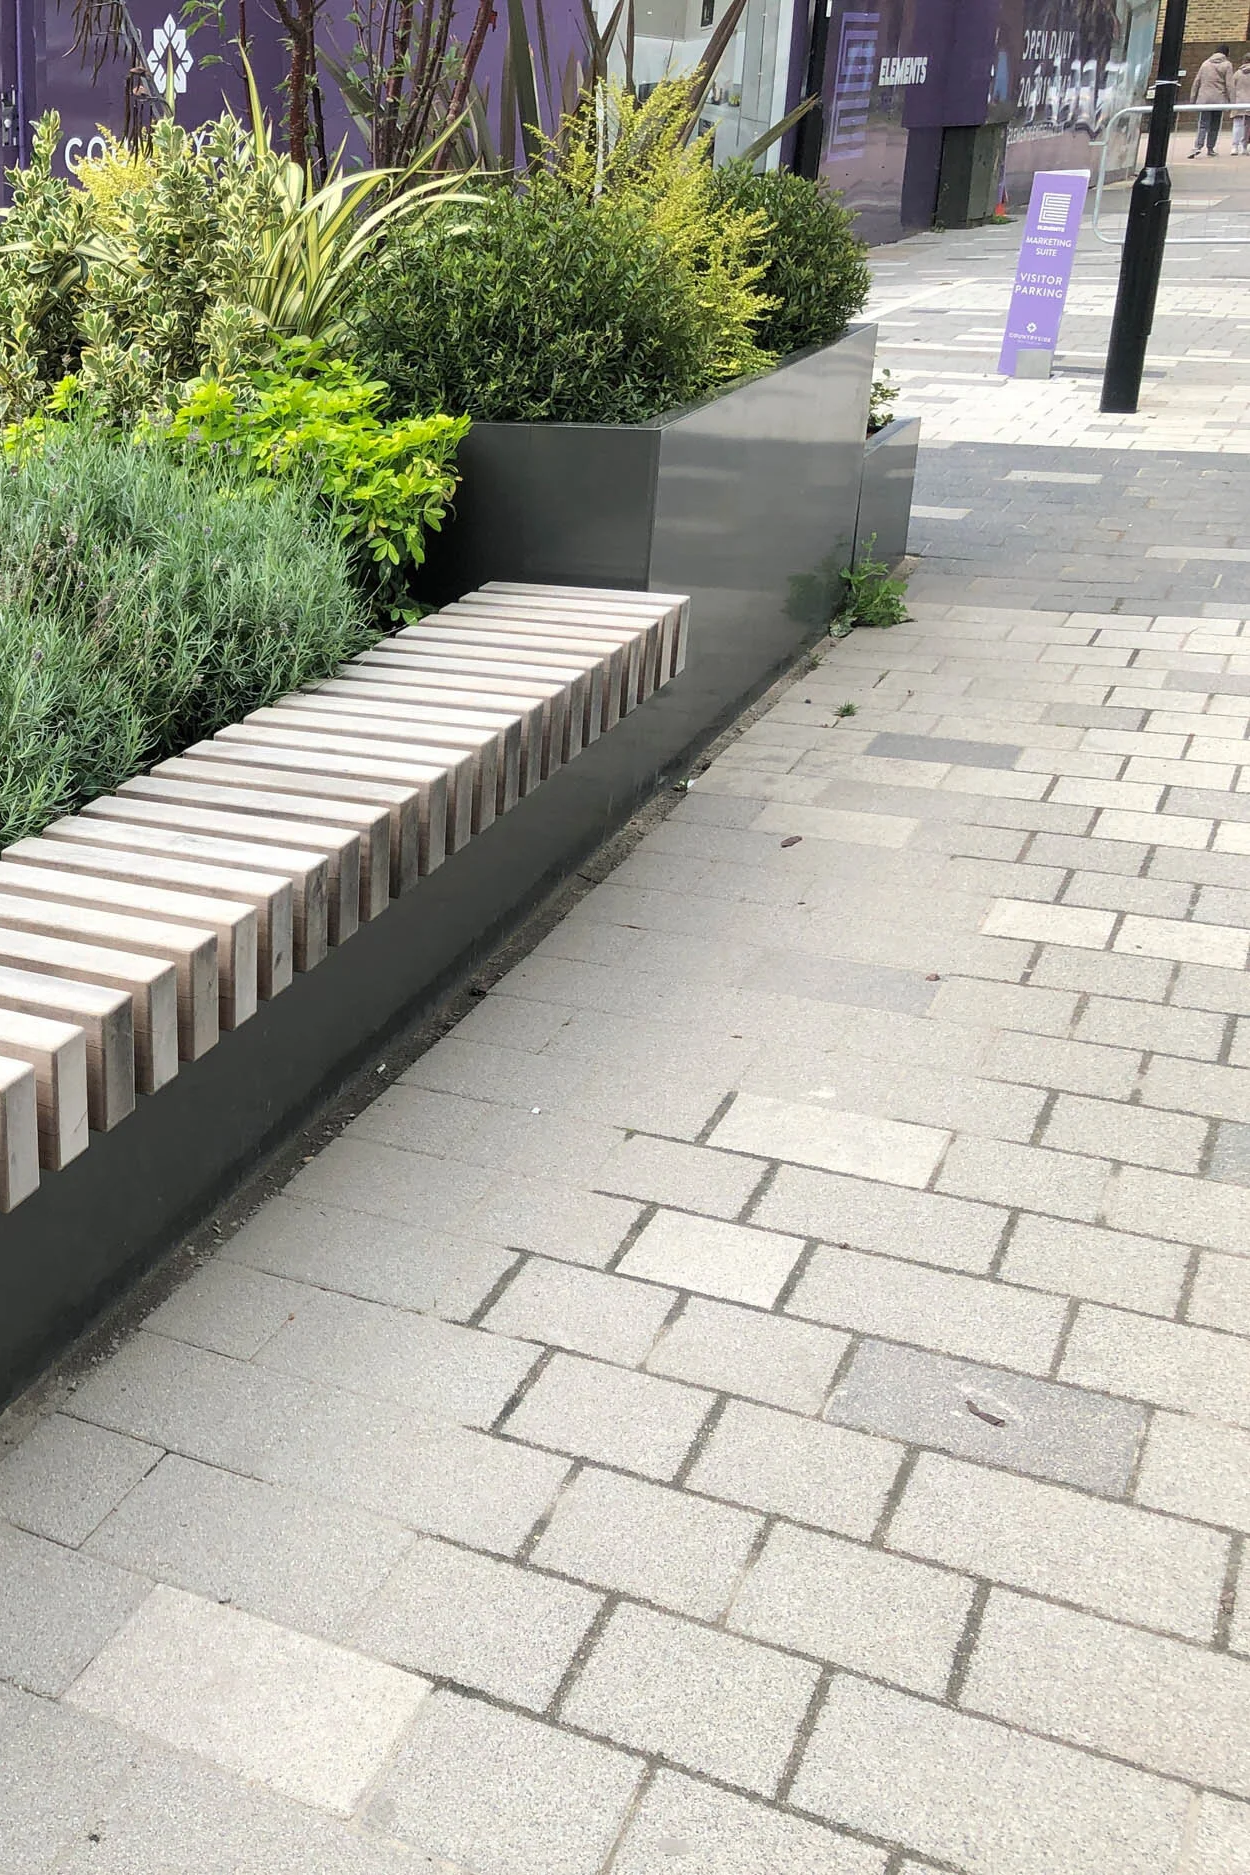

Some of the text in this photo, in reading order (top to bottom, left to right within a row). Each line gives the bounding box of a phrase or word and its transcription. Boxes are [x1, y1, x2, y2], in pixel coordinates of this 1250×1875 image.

[1049, 30, 1075, 60] DAILY
[878, 57, 928, 86] ELEMENTS
[1026, 236, 1072, 247] MARKETING
[1036, 247, 1057, 257] SUITE
[1020, 272, 1063, 285] VISITOR
[1015, 284, 1063, 299] PARKING
